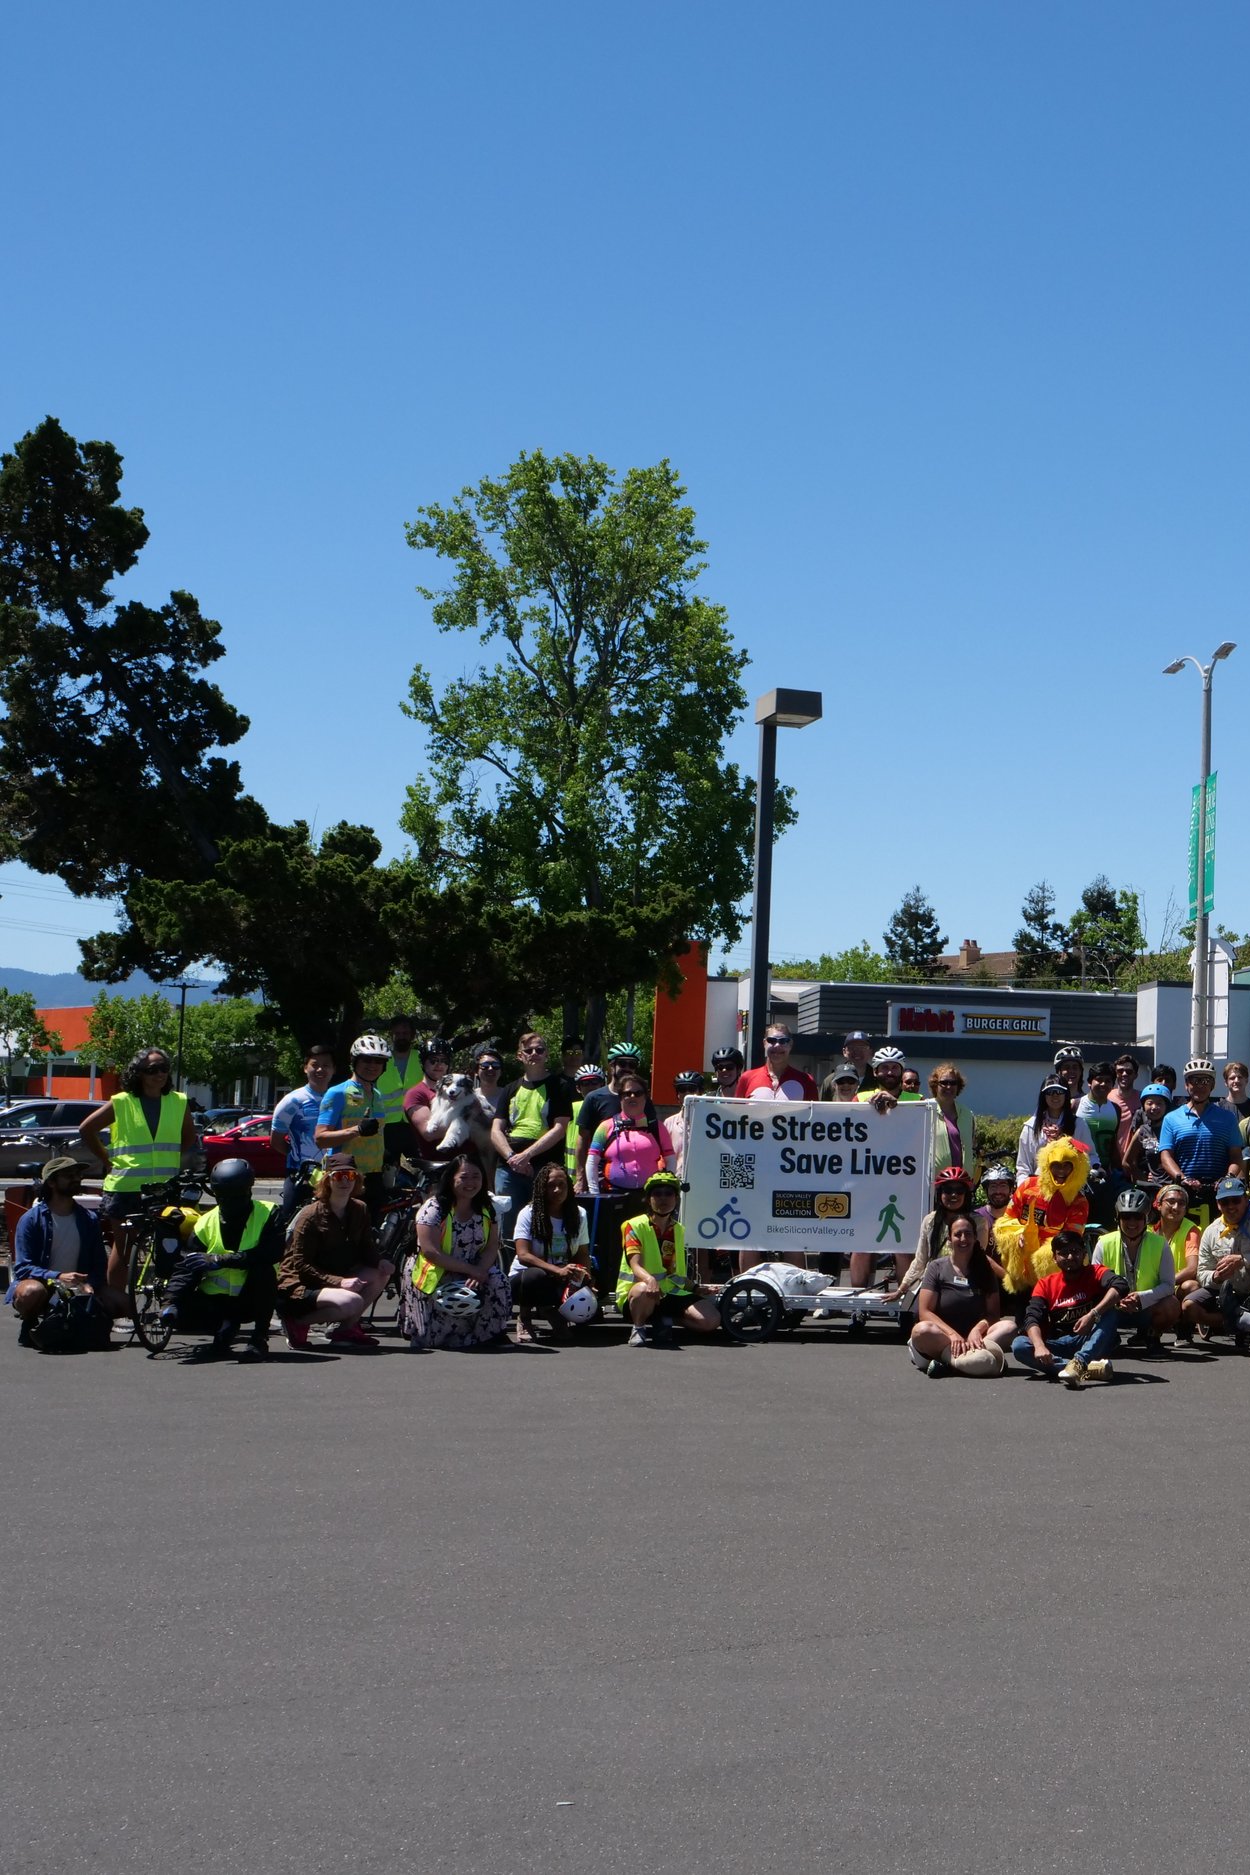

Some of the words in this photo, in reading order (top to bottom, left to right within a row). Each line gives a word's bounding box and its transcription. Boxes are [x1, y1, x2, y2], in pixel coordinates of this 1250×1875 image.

[966, 1017, 1010, 1030] BURGER
[1012, 1019, 1042, 1032] GRILL
[705, 1112, 765, 1141] Safe
[772, 1114, 868, 1143] Streets
[779, 1147, 843, 1175] Save
[851, 1148, 917, 1176] Lives
[775, 1199, 812, 1208] BICYCLE
[766, 1225, 855, 1237] BikeSiliconValley.org
